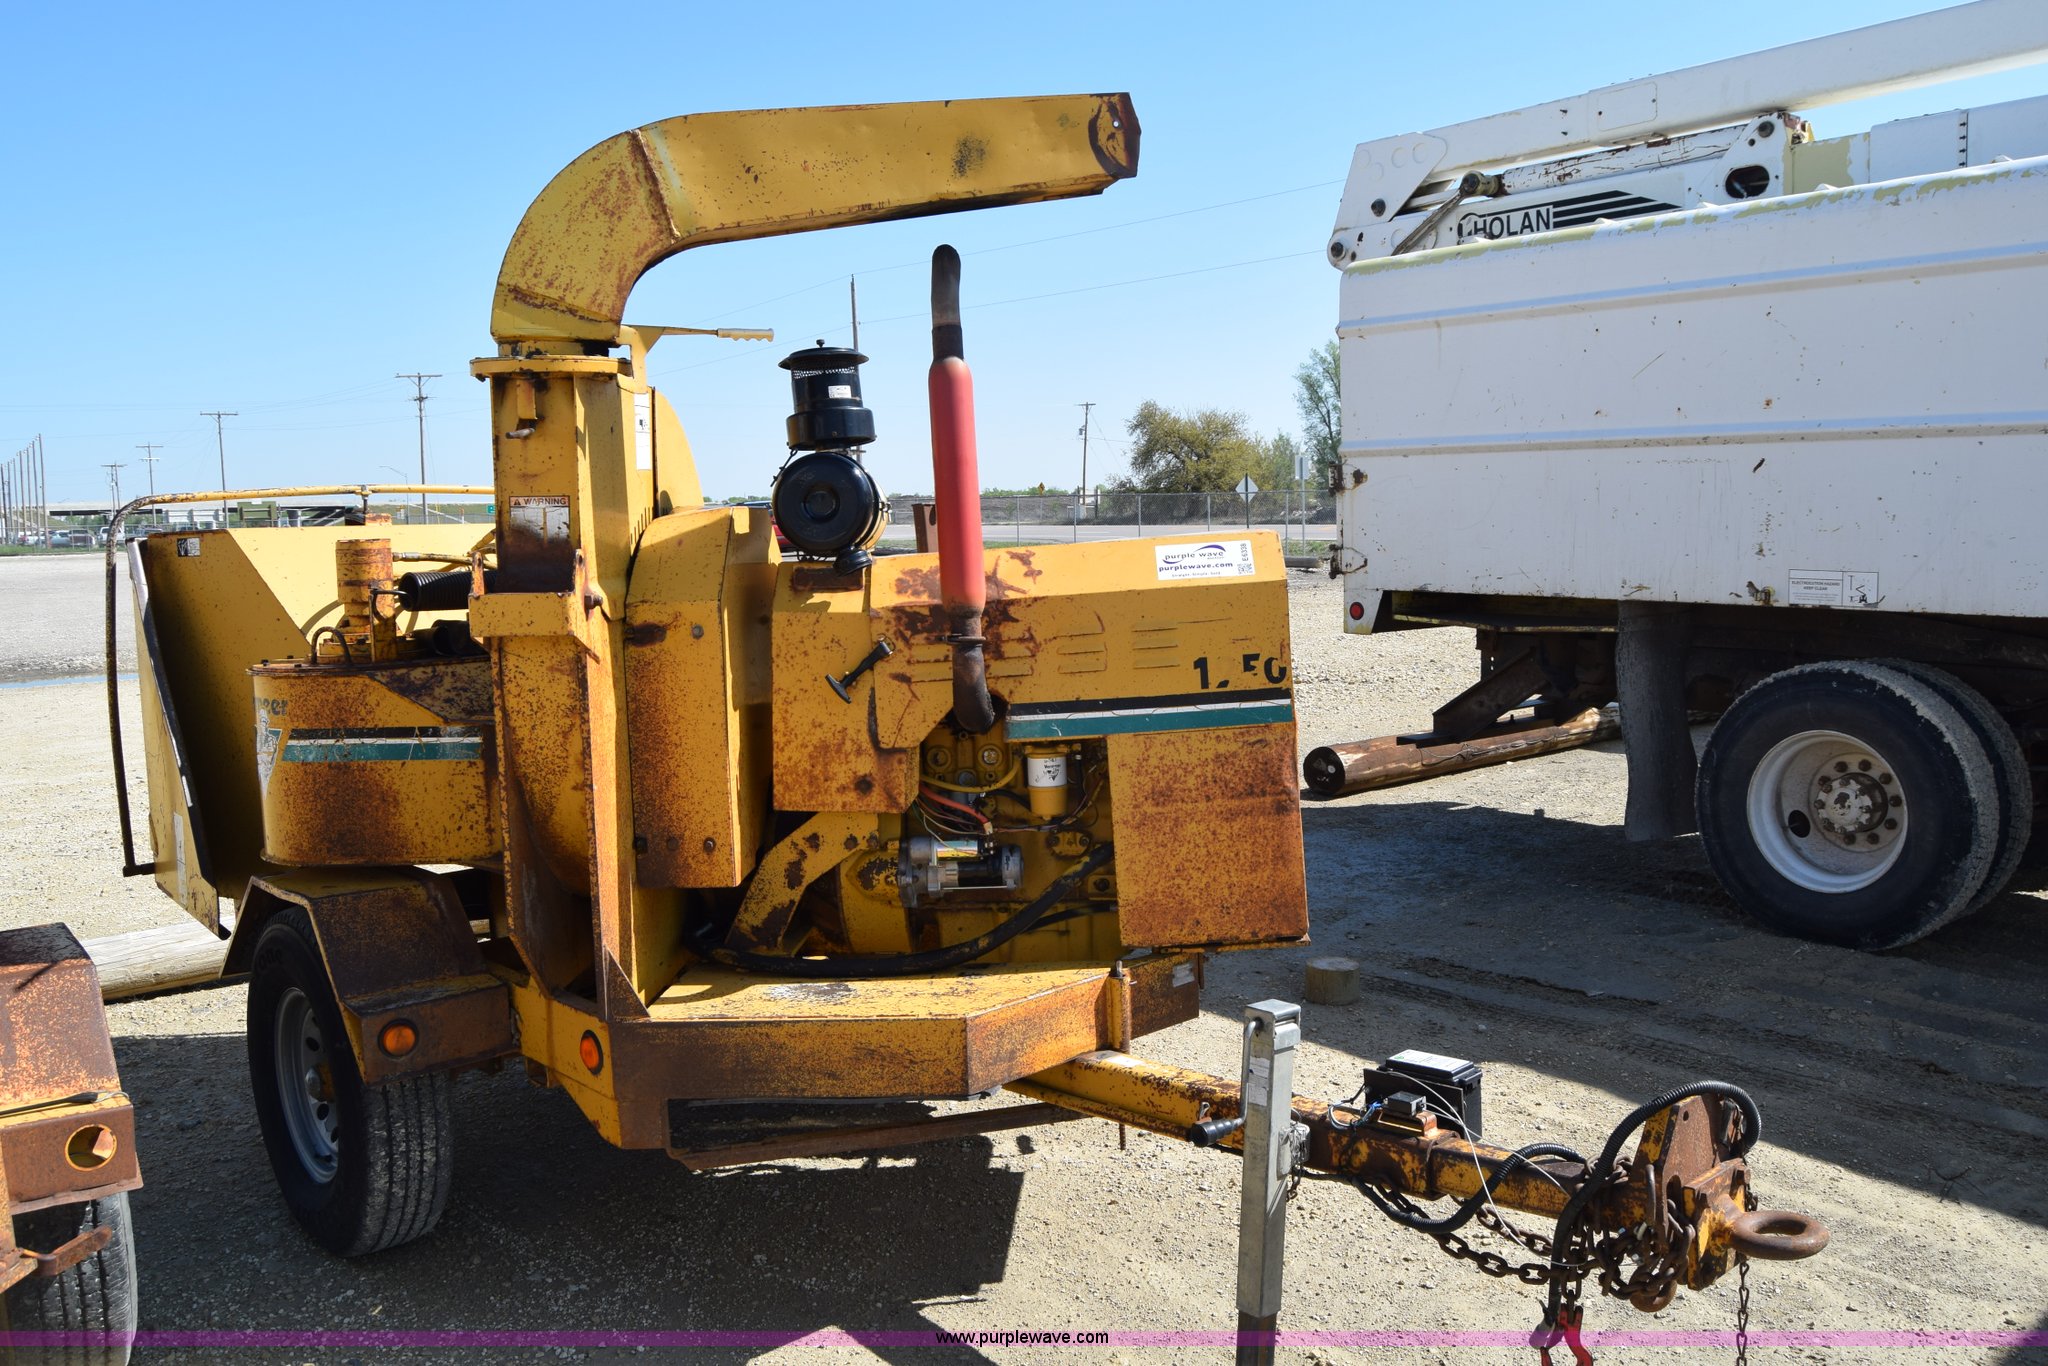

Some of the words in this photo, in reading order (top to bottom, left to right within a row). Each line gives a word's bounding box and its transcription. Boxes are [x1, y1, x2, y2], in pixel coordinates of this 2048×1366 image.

[523, 497, 567, 506] WARNING
[1159, 562, 1234, 572] purplewave.com
[1193, 653, 1287, 689] 150
